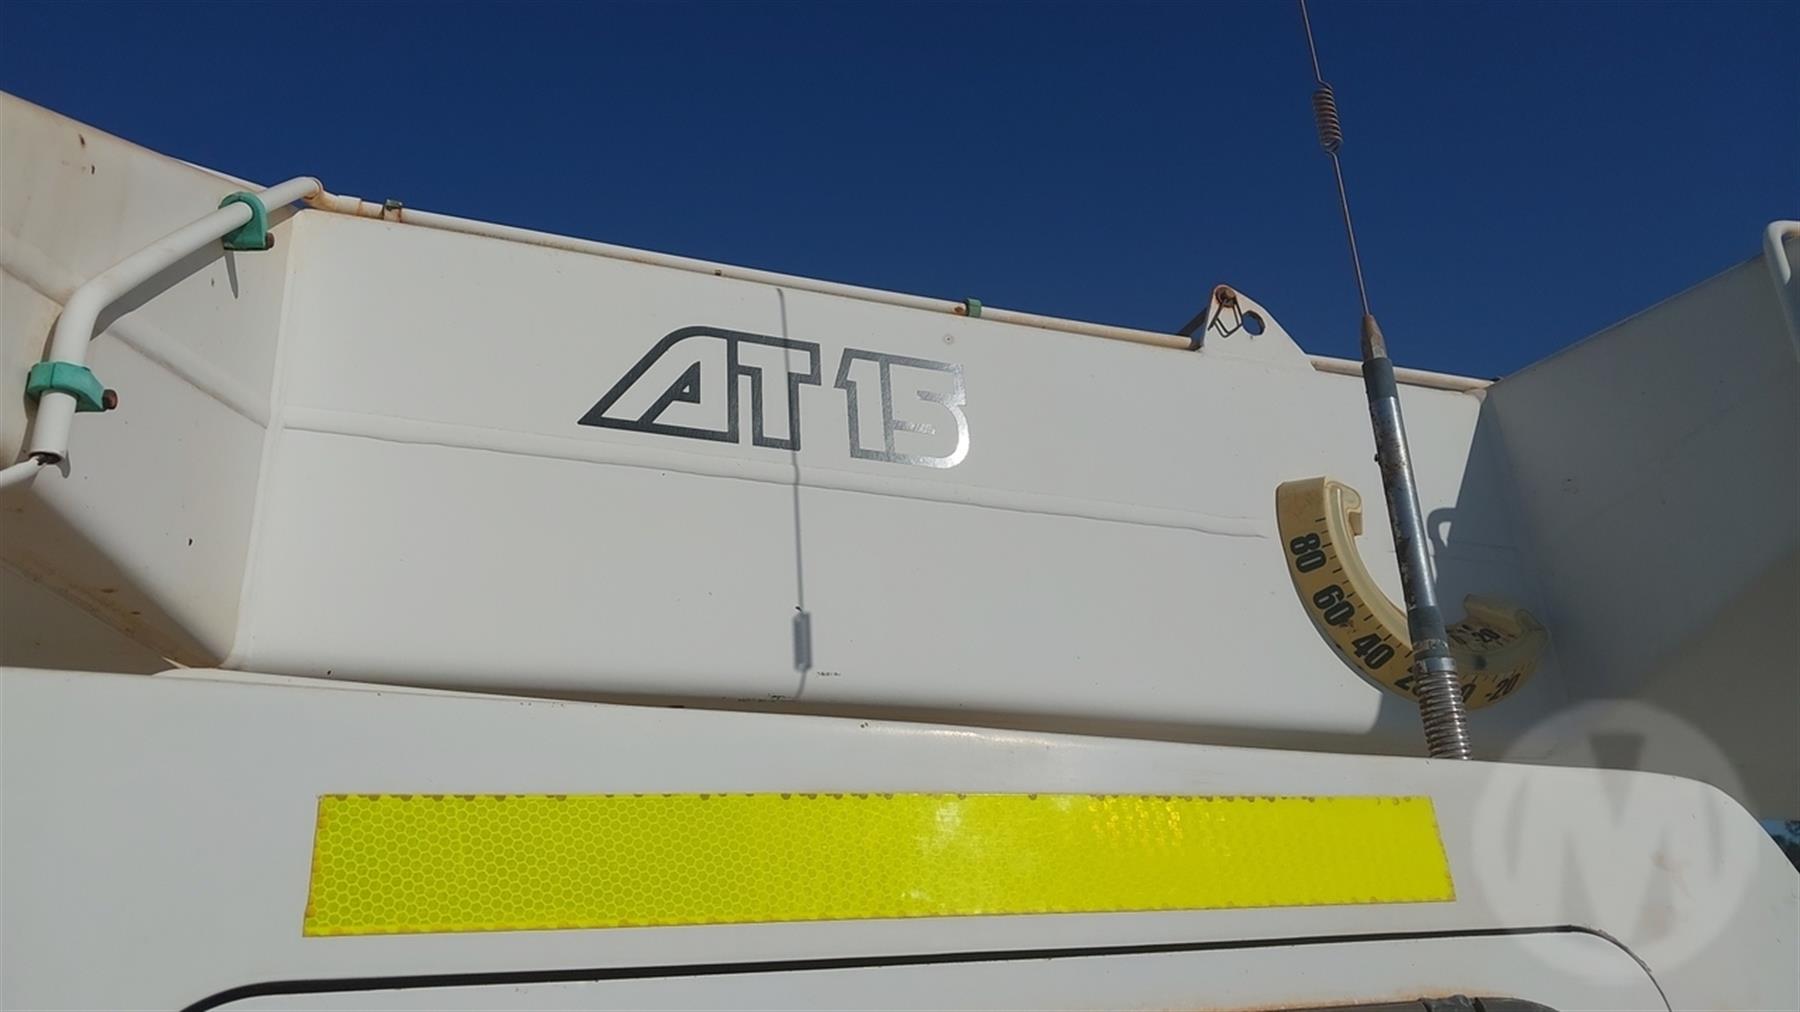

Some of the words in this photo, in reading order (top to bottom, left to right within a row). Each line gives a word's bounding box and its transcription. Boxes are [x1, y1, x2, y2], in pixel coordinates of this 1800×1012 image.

[577, 325, 822, 451] AT
[834, 348, 970, 470] 15
[1290, 532, 1327, 573] 80
[1313, 584, 1356, 626] 60
[1352, 633, 1395, 670] 40
